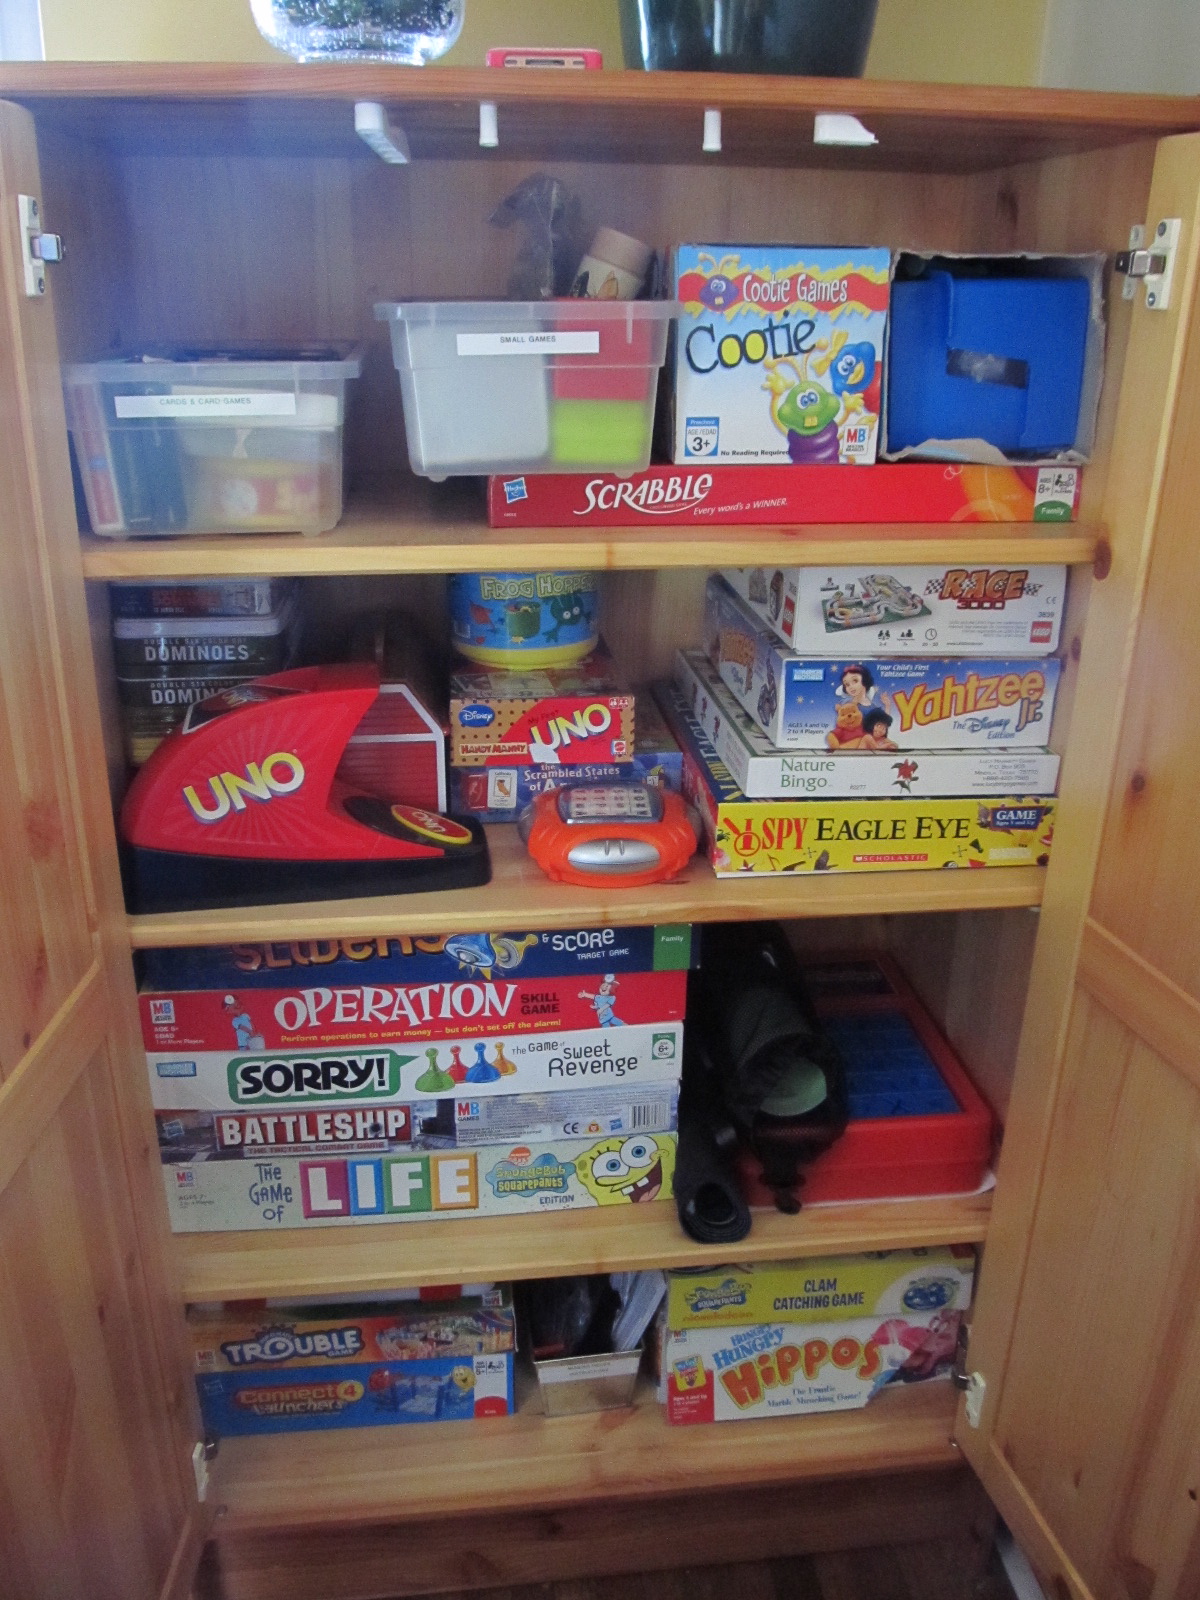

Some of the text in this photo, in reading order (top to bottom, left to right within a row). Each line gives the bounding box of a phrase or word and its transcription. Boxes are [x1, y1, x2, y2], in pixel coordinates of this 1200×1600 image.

[742, 274, 848, 303] Cootie Games
[500, 335, 556, 344] SMALL GAMES
[685, 309, 816, 374] Cootie
[159, 398, 187, 406] CARDS
[223, 397, 252, 405] GAMES
[847, 427, 866, 443] MB
[692, 436, 711, 452] 3+
[693, 506, 716, 516] Every
[718, 502, 743, 513] word's
[1041, 507, 1065, 516] Family
[481, 579, 533, 600] FROG
[940, 569, 1029, 600] RACE
[144, 645, 249, 661] DOMINOES
[892, 670, 1046, 733] Yahtzee
[462, 709, 492, 721] Disney
[531, 703, 612, 749] UNO
[953, 717, 1010, 734] The Disney
[987, 731, 1015, 740] Edition
[461, 744, 526, 754] HANDY MANNY
[541, 764, 556, 772] the
[781, 758, 836, 772] Nature
[524, 766, 620, 782] Scrambled States
[183, 752, 305, 825] UNO
[529, 783, 541, 792] of
[781, 775, 828, 792] Bingo
[996, 810, 1037, 820] GAME
[762, 817, 808, 850] SPY
[814, 816, 970, 841] EAGLE EYE
[542, 934, 549, 943] &
[577, 949, 629, 960] TARGET GAME
[521, 993, 560, 1004] SKILL
[153, 1002, 171, 1014] MB
[274, 983, 518, 1031] OPERATION
[521, 1003, 560, 1015] GAME
[321, 1033, 366, 1041] operations
[404, 1029, 431, 1037] money
[534, 1019, 561, 1028] alarm!
[512, 1046, 527, 1055] The
[528, 1041, 559, 1053] Game
[548, 1056, 638, 1077] Revenge
[239, 1058, 386, 1096] SORRY!
[458, 1102, 479, 1116] MB
[221, 1110, 406, 1147] BATTLESHIP
[177, 1171, 194, 1182] MB
[307, 1158, 471, 1211] LIFE
[804, 1279, 837, 1292] CLAM
[773, 1293, 865, 1310] CATCHING GAME
[225, 1329, 361, 1363] TROUBLE
